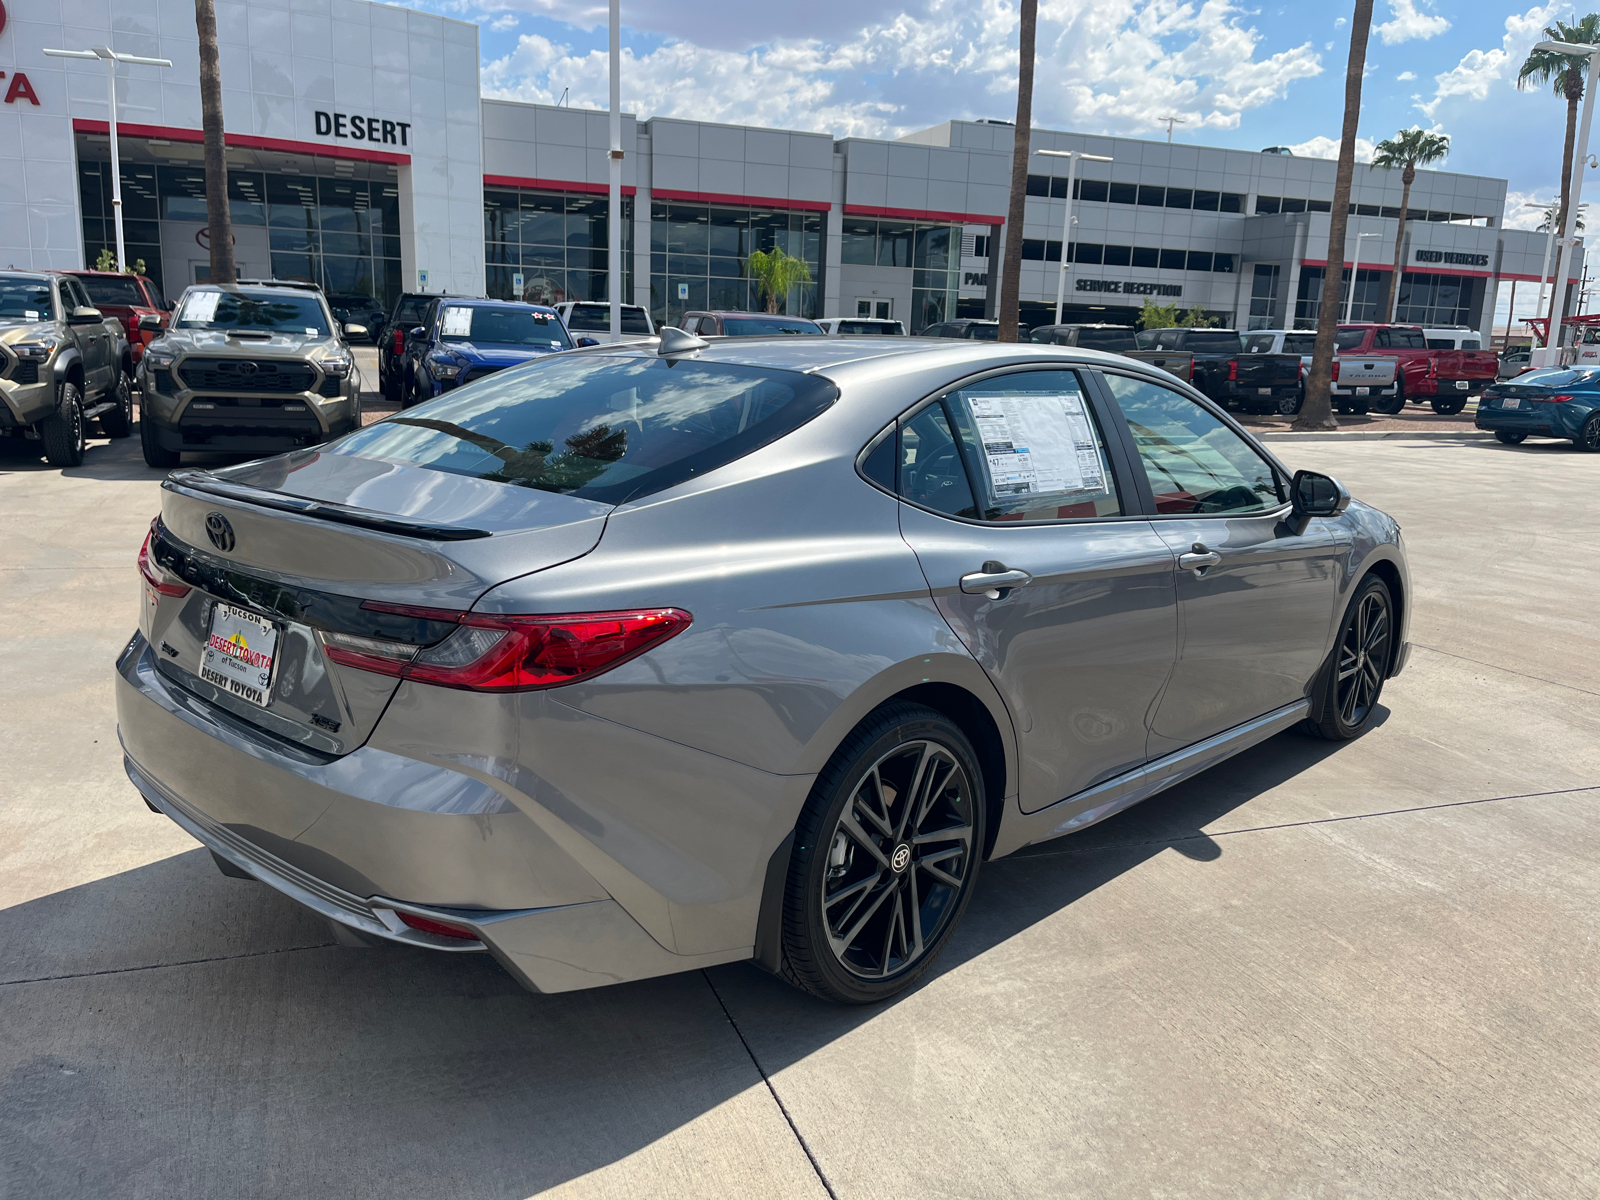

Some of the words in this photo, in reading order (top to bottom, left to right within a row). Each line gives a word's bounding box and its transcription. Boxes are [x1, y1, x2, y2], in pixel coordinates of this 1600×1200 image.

[0, 71, 41, 106] A
[315, 111, 411, 146] DESERT
[1416, 250, 1443, 263] USED
[1444, 252, 1489, 267] VEHICLES
[1075, 279, 1122, 293] SERVICE
[1123, 281, 1183, 297] RECEPTION
[227, 606, 261, 625] TUCSON
[209, 634, 237, 656] DESERT
[238, 646, 272, 670] TOYOTA
[228, 658, 247, 673] Tucson
[201, 666, 229, 688] DESERT
[229, 679, 263, 704] TOYOTA
